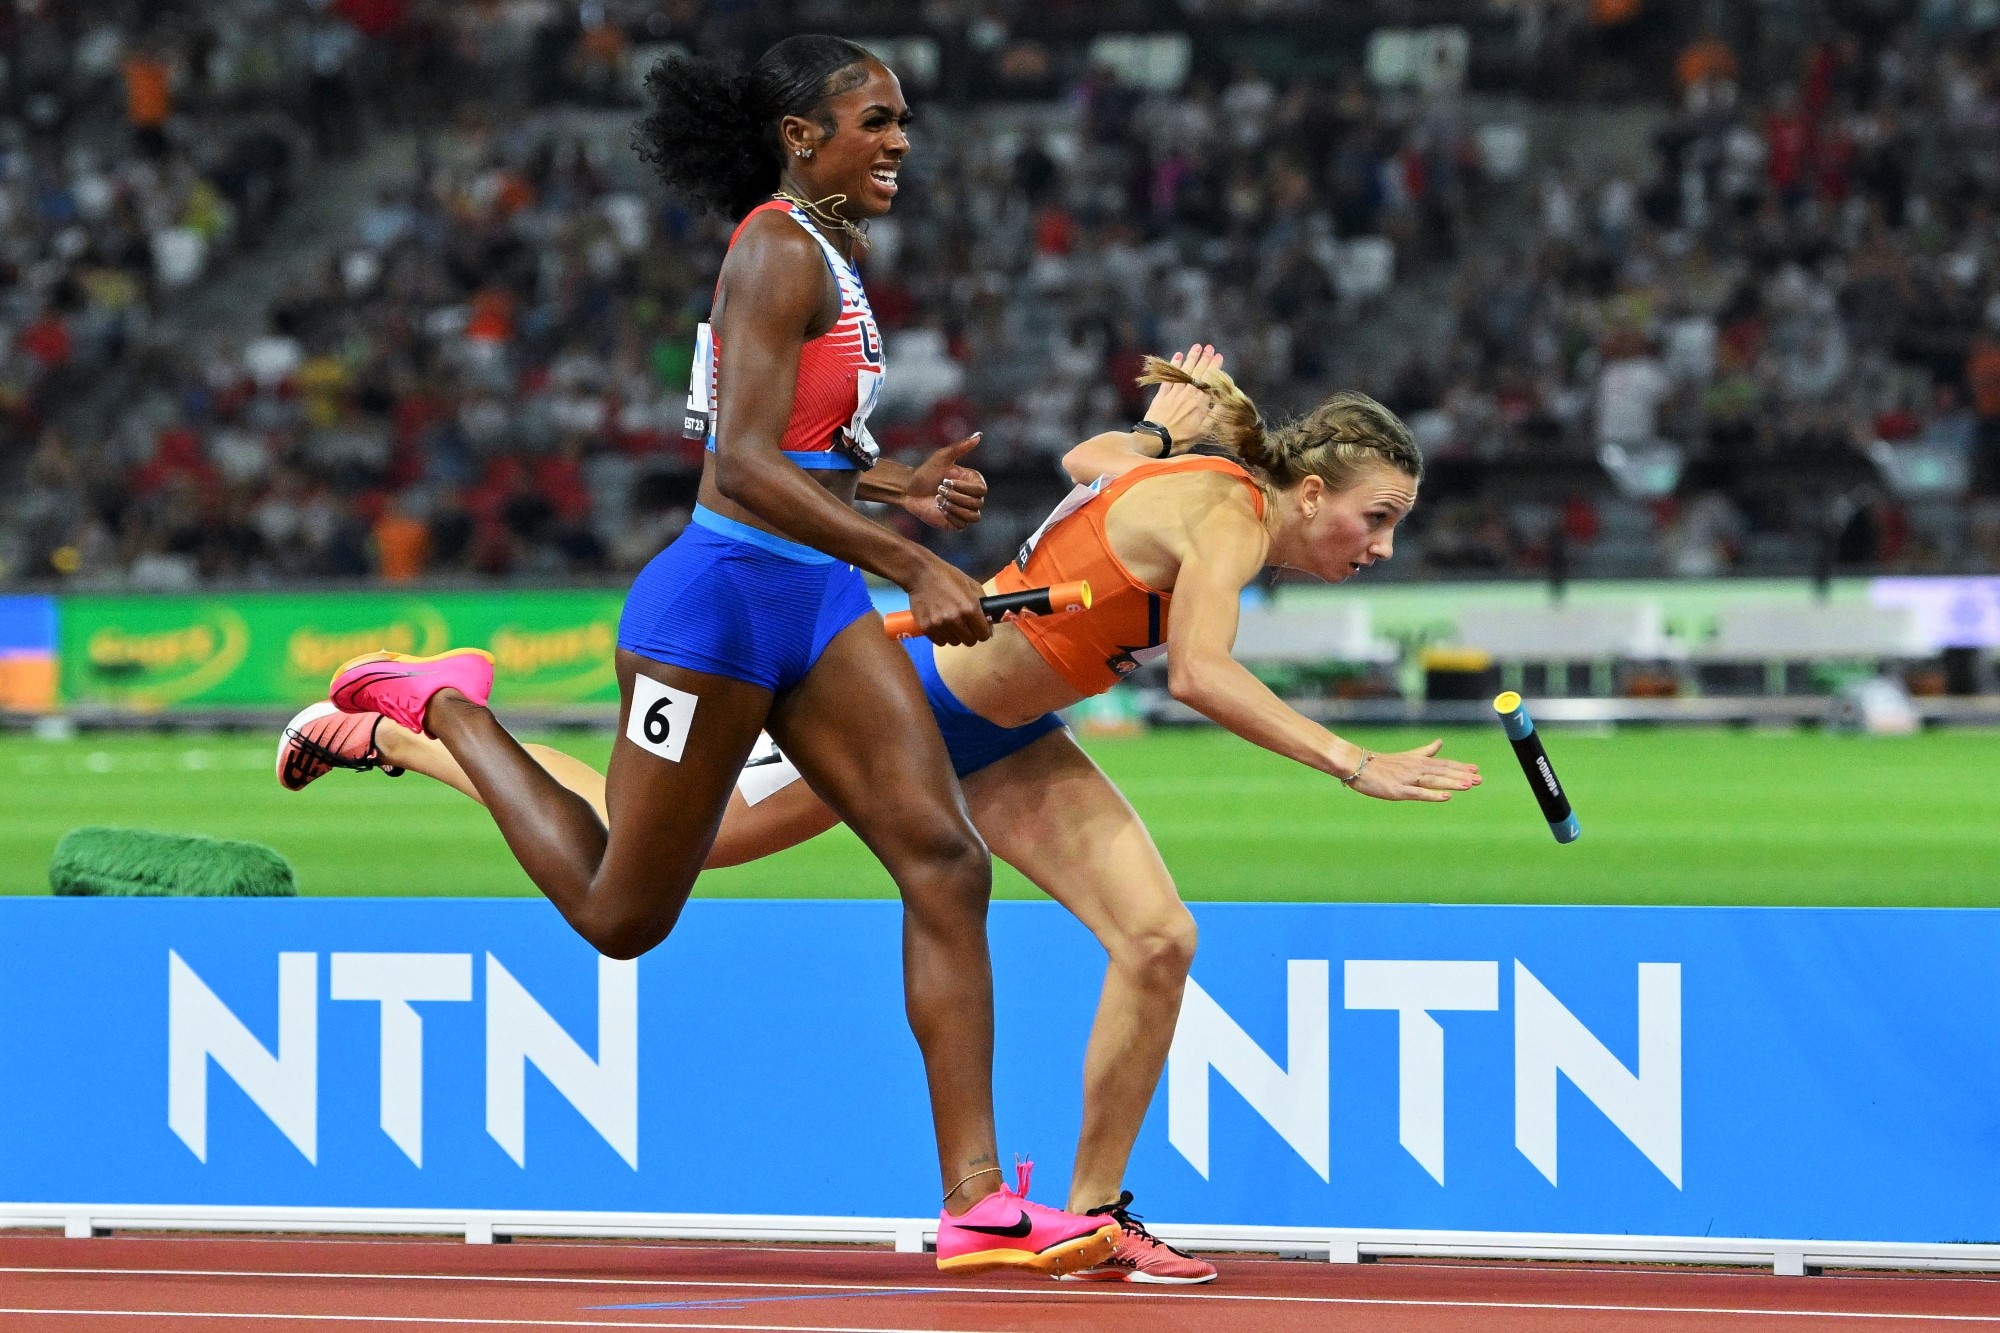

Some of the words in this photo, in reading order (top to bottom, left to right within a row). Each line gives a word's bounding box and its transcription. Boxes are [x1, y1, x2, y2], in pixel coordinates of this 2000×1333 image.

[695, 418, 705, 431] 23
[644, 697, 673, 744] 6
[1535, 755, 1558, 792] MONDO
[169, 948, 638, 1172] NTN
[1168, 957, 1682, 1191] NTN
